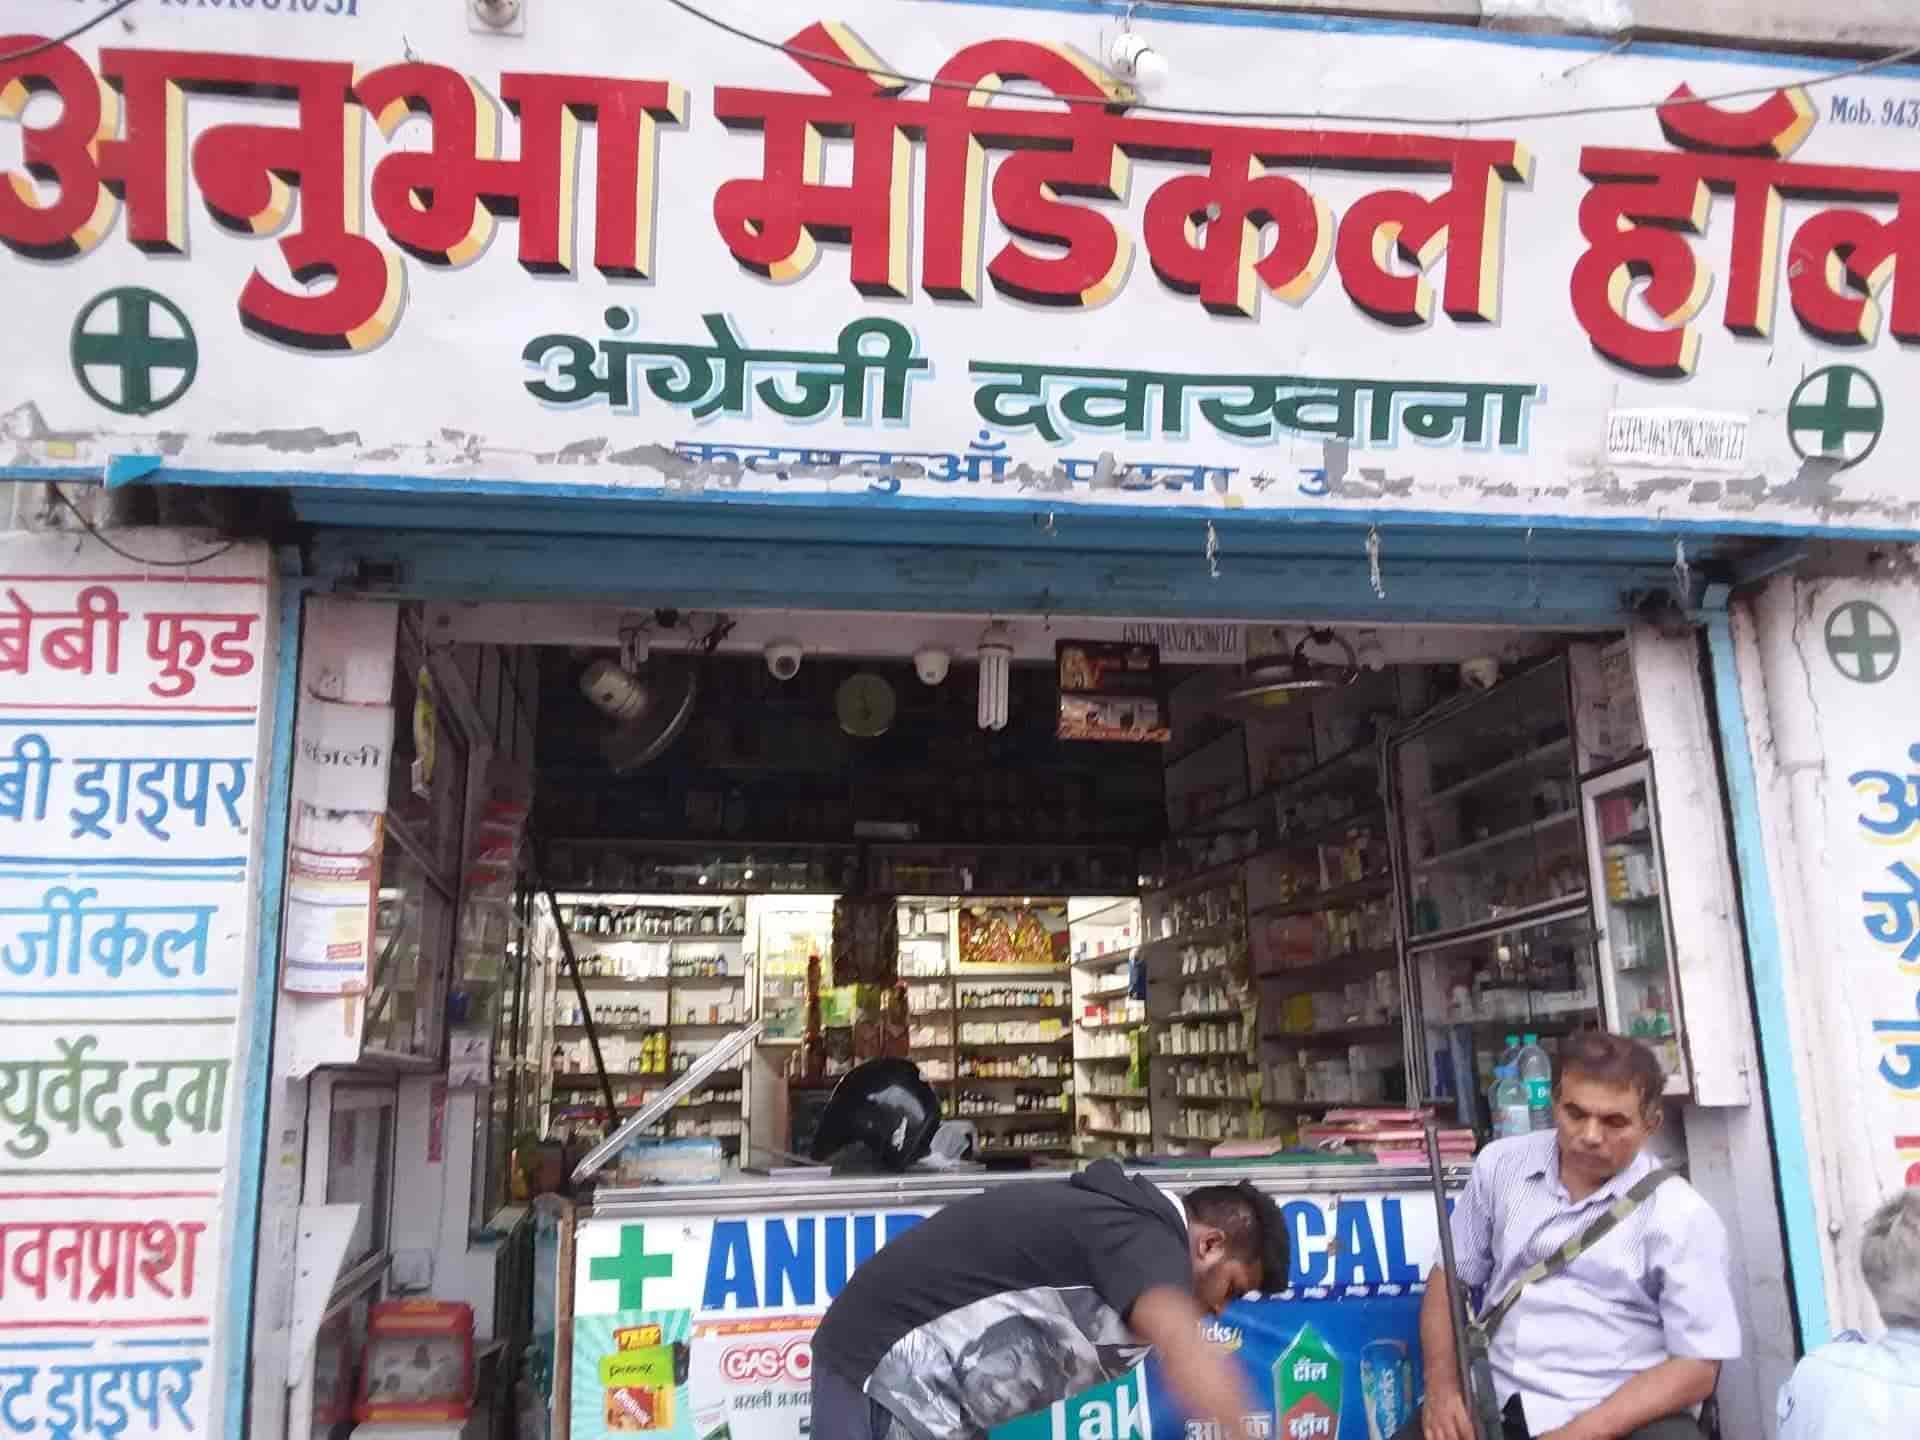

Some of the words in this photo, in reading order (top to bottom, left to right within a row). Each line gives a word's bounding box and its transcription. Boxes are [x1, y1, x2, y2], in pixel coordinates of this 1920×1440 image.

[1829, 95, 1875, 124] Mob.
[1880, 97, 1920, 132] 943
[0, 33, 690, 354] अनुभा
[714, 20, 1536, 328] मेडिकल
[1570, 80, 1920, 380] हॉल
[521, 304, 930, 424] अंग्रेजी
[968, 359, 1540, 452] दवाखाना
[0, 586, 128, 675] बेबी
[143, 612, 260, 698] फुड
[0, 733, 62, 822] बी
[71, 757, 252, 842] ड्राइपर
[0, 885, 218, 978] र्जीकल
[0, 1035, 129, 1159] युर्वेद
[0, 1220, 207, 1304] वनप्राश
[701, 1213, 928, 1310] ANU
